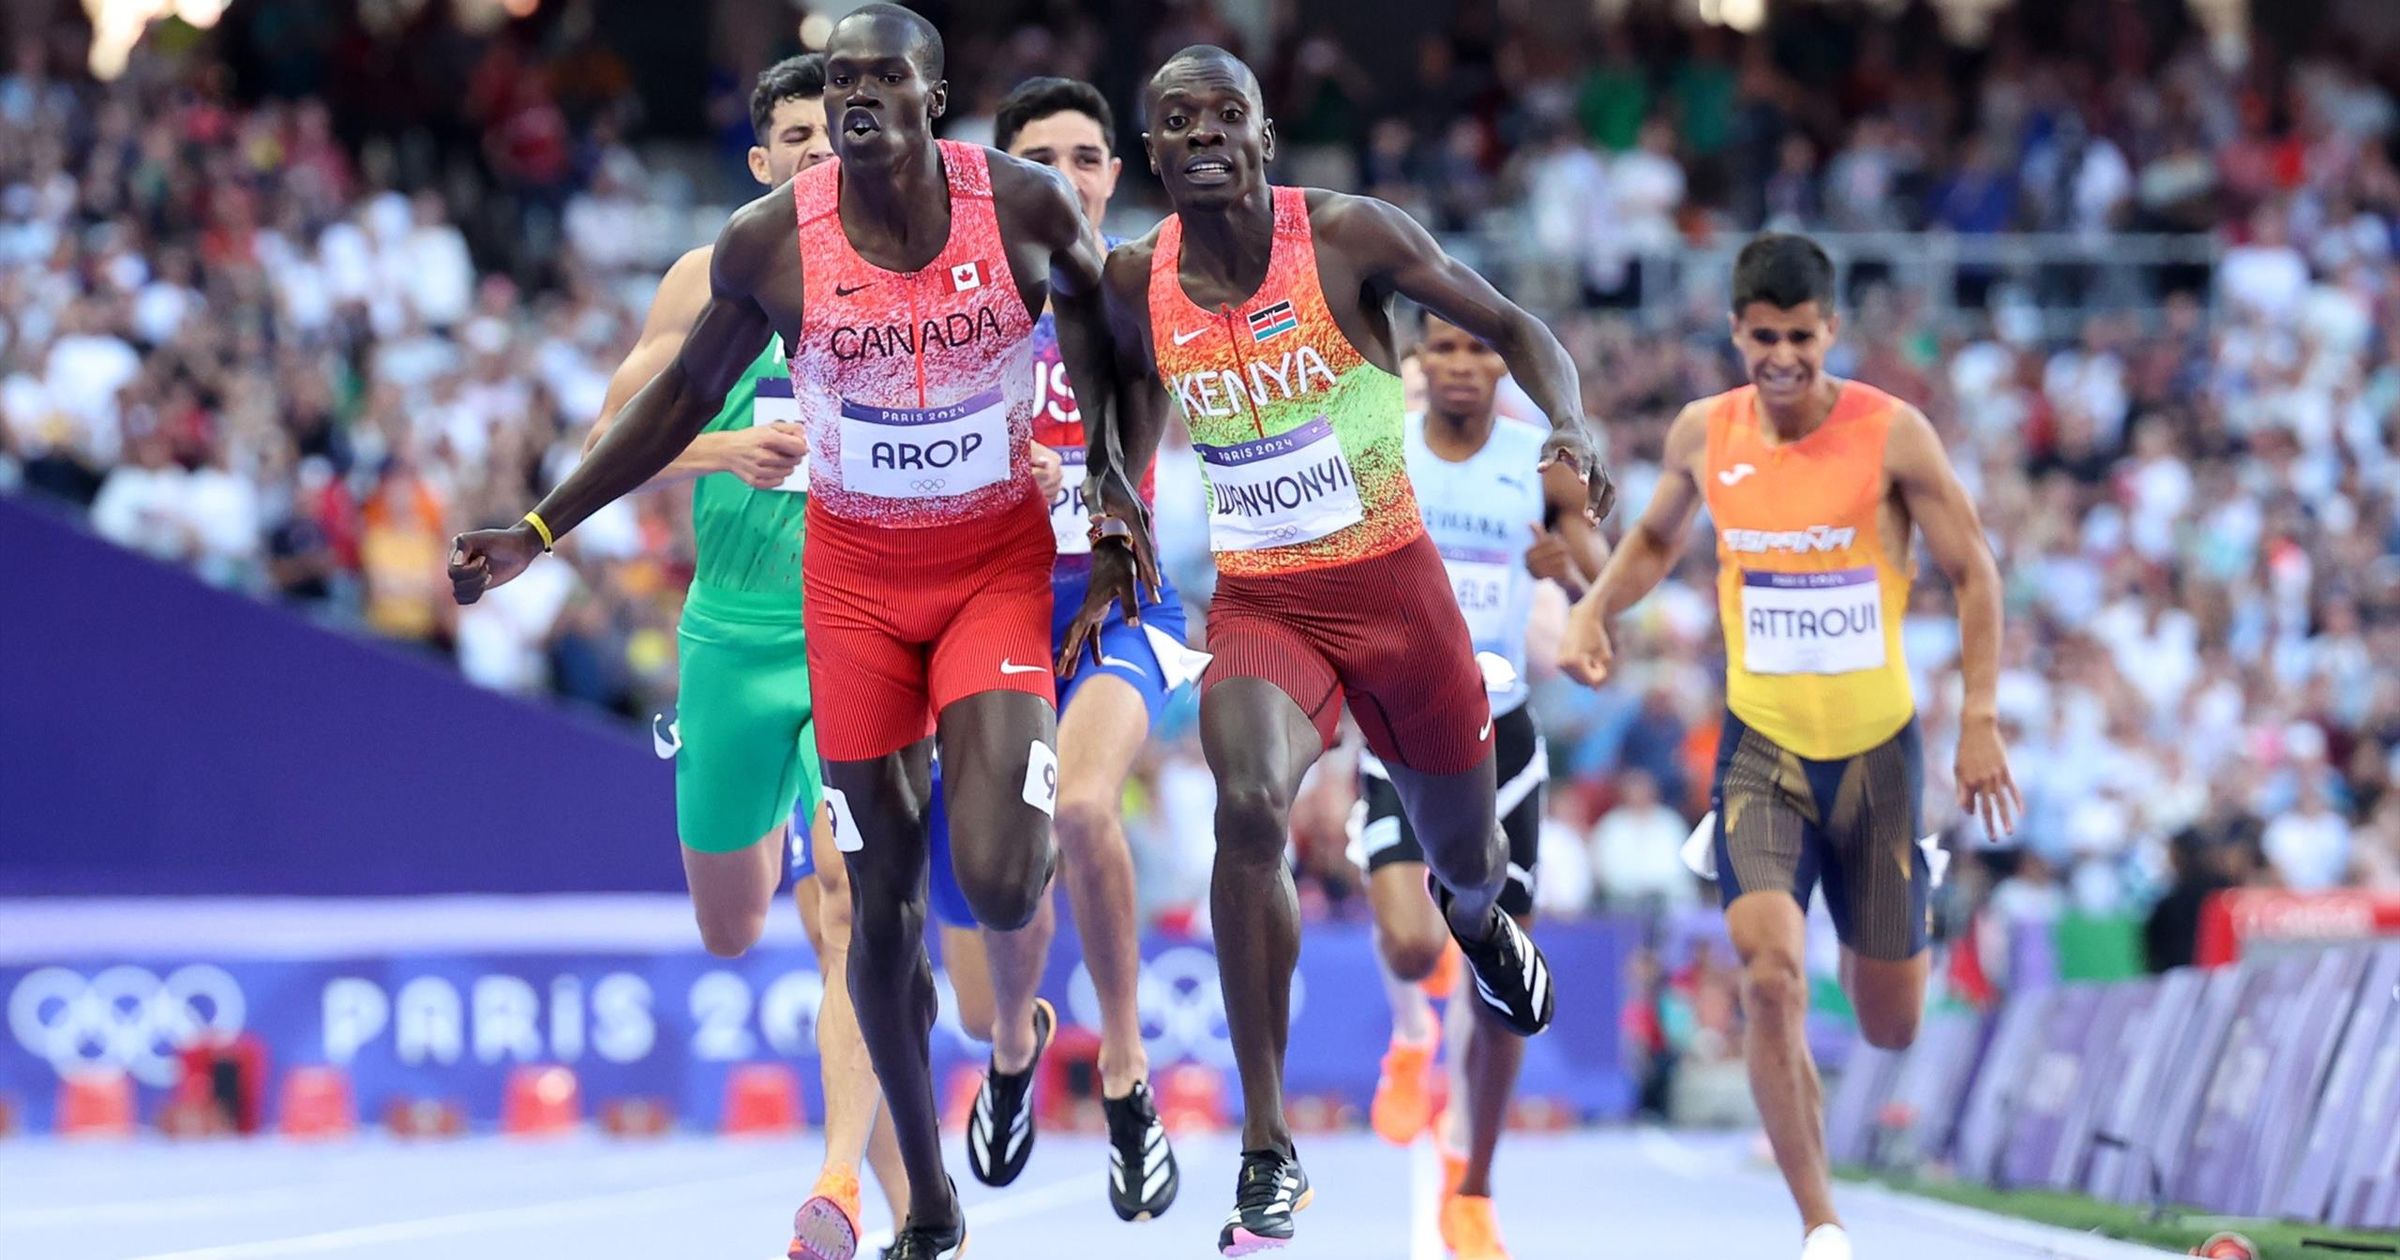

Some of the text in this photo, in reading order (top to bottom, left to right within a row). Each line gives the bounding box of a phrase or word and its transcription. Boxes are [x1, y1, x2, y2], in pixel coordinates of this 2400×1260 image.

[831, 306, 1001, 361] CANADA
[1033, 361, 1083, 424] US
[1171, 345, 1337, 419] KENYA
[882, 406, 965, 422] PARIS 2024
[871, 432, 983, 470] AROP
[1219, 439, 1293, 463] PARIS 2024
[1214, 455, 1348, 517] WANYONYI
[1722, 525, 1857, 554] ESPAÑA
[1750, 602, 1878, 639] ATTAOUI
[1043, 763, 1056, 800] 9
[321, 971, 657, 1065] PARIS
